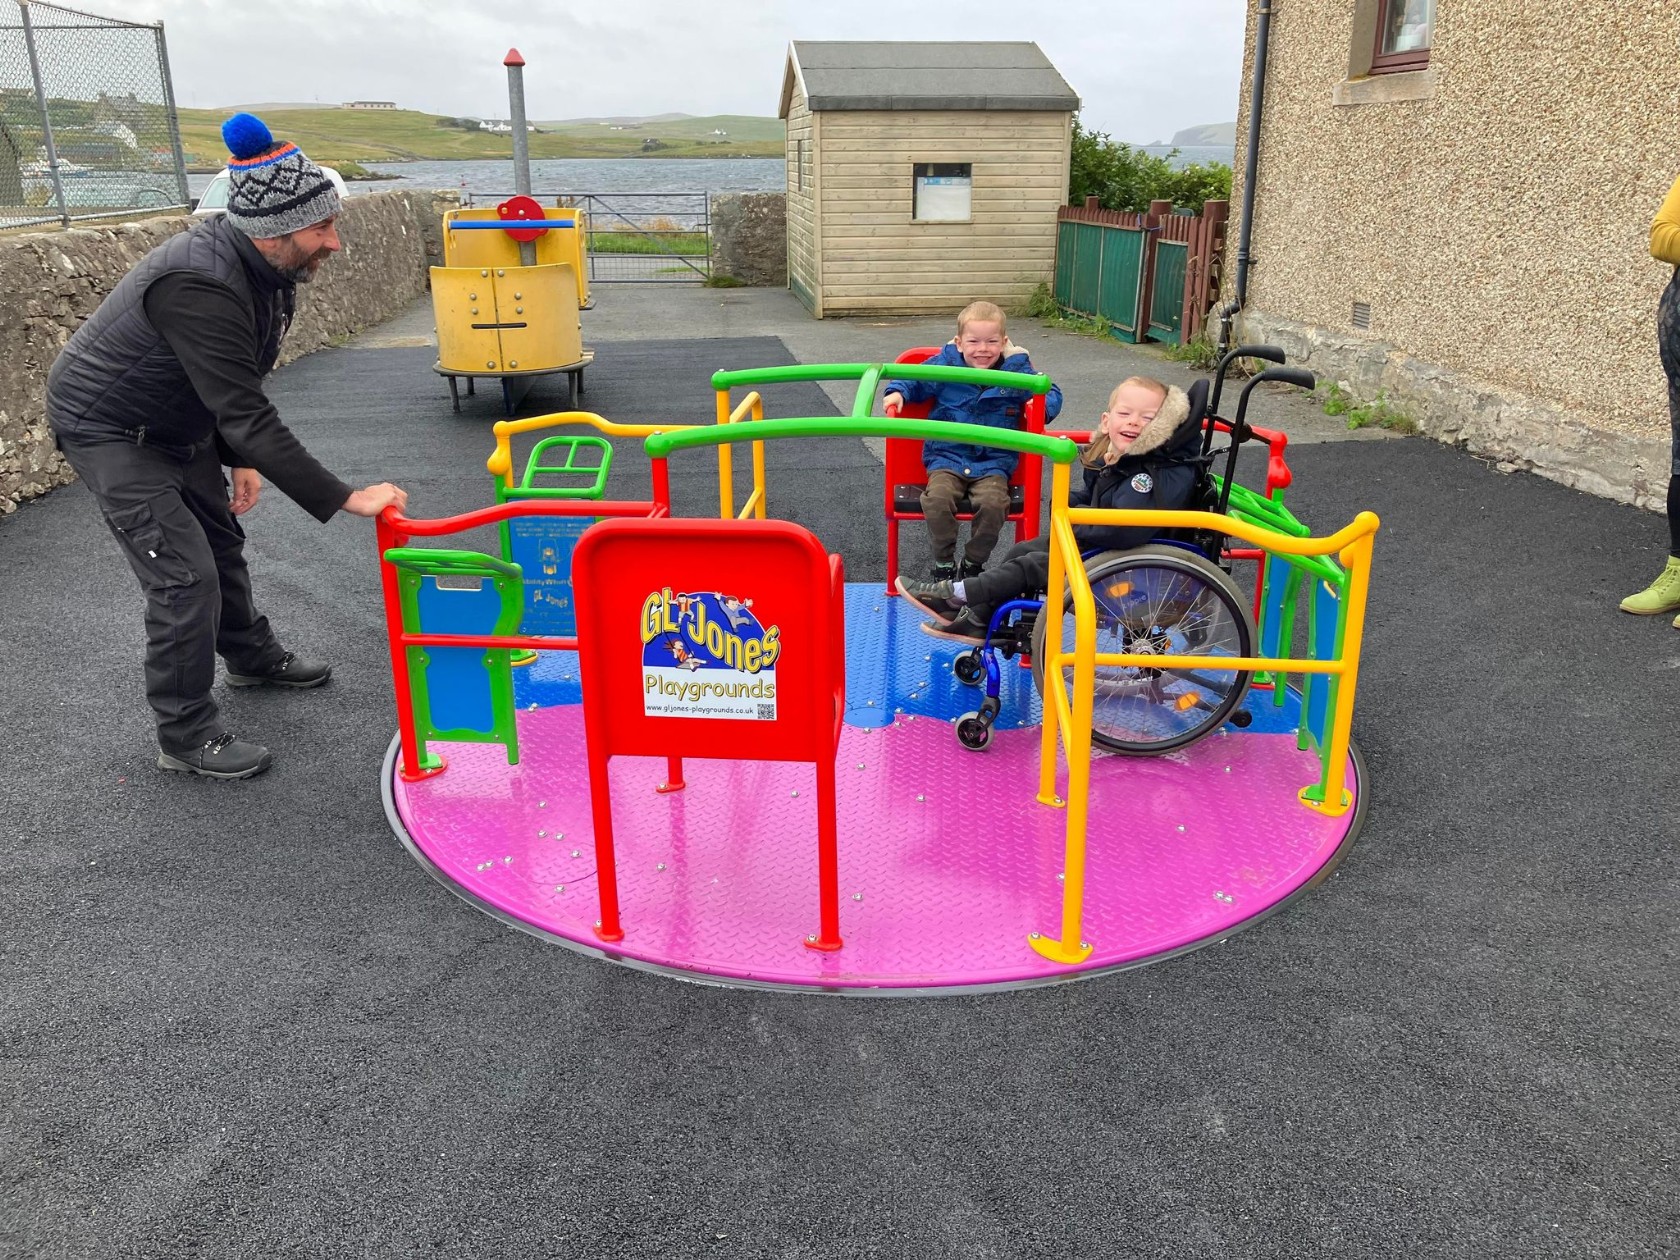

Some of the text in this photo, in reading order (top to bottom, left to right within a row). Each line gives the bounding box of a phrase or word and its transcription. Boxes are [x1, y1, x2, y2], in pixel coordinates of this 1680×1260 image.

[640, 587, 780, 674] GL Jones
[645, 674, 775, 701] Playgrounds
[646, 704, 754, 714] www.gljones-playgrounds.co.uk
